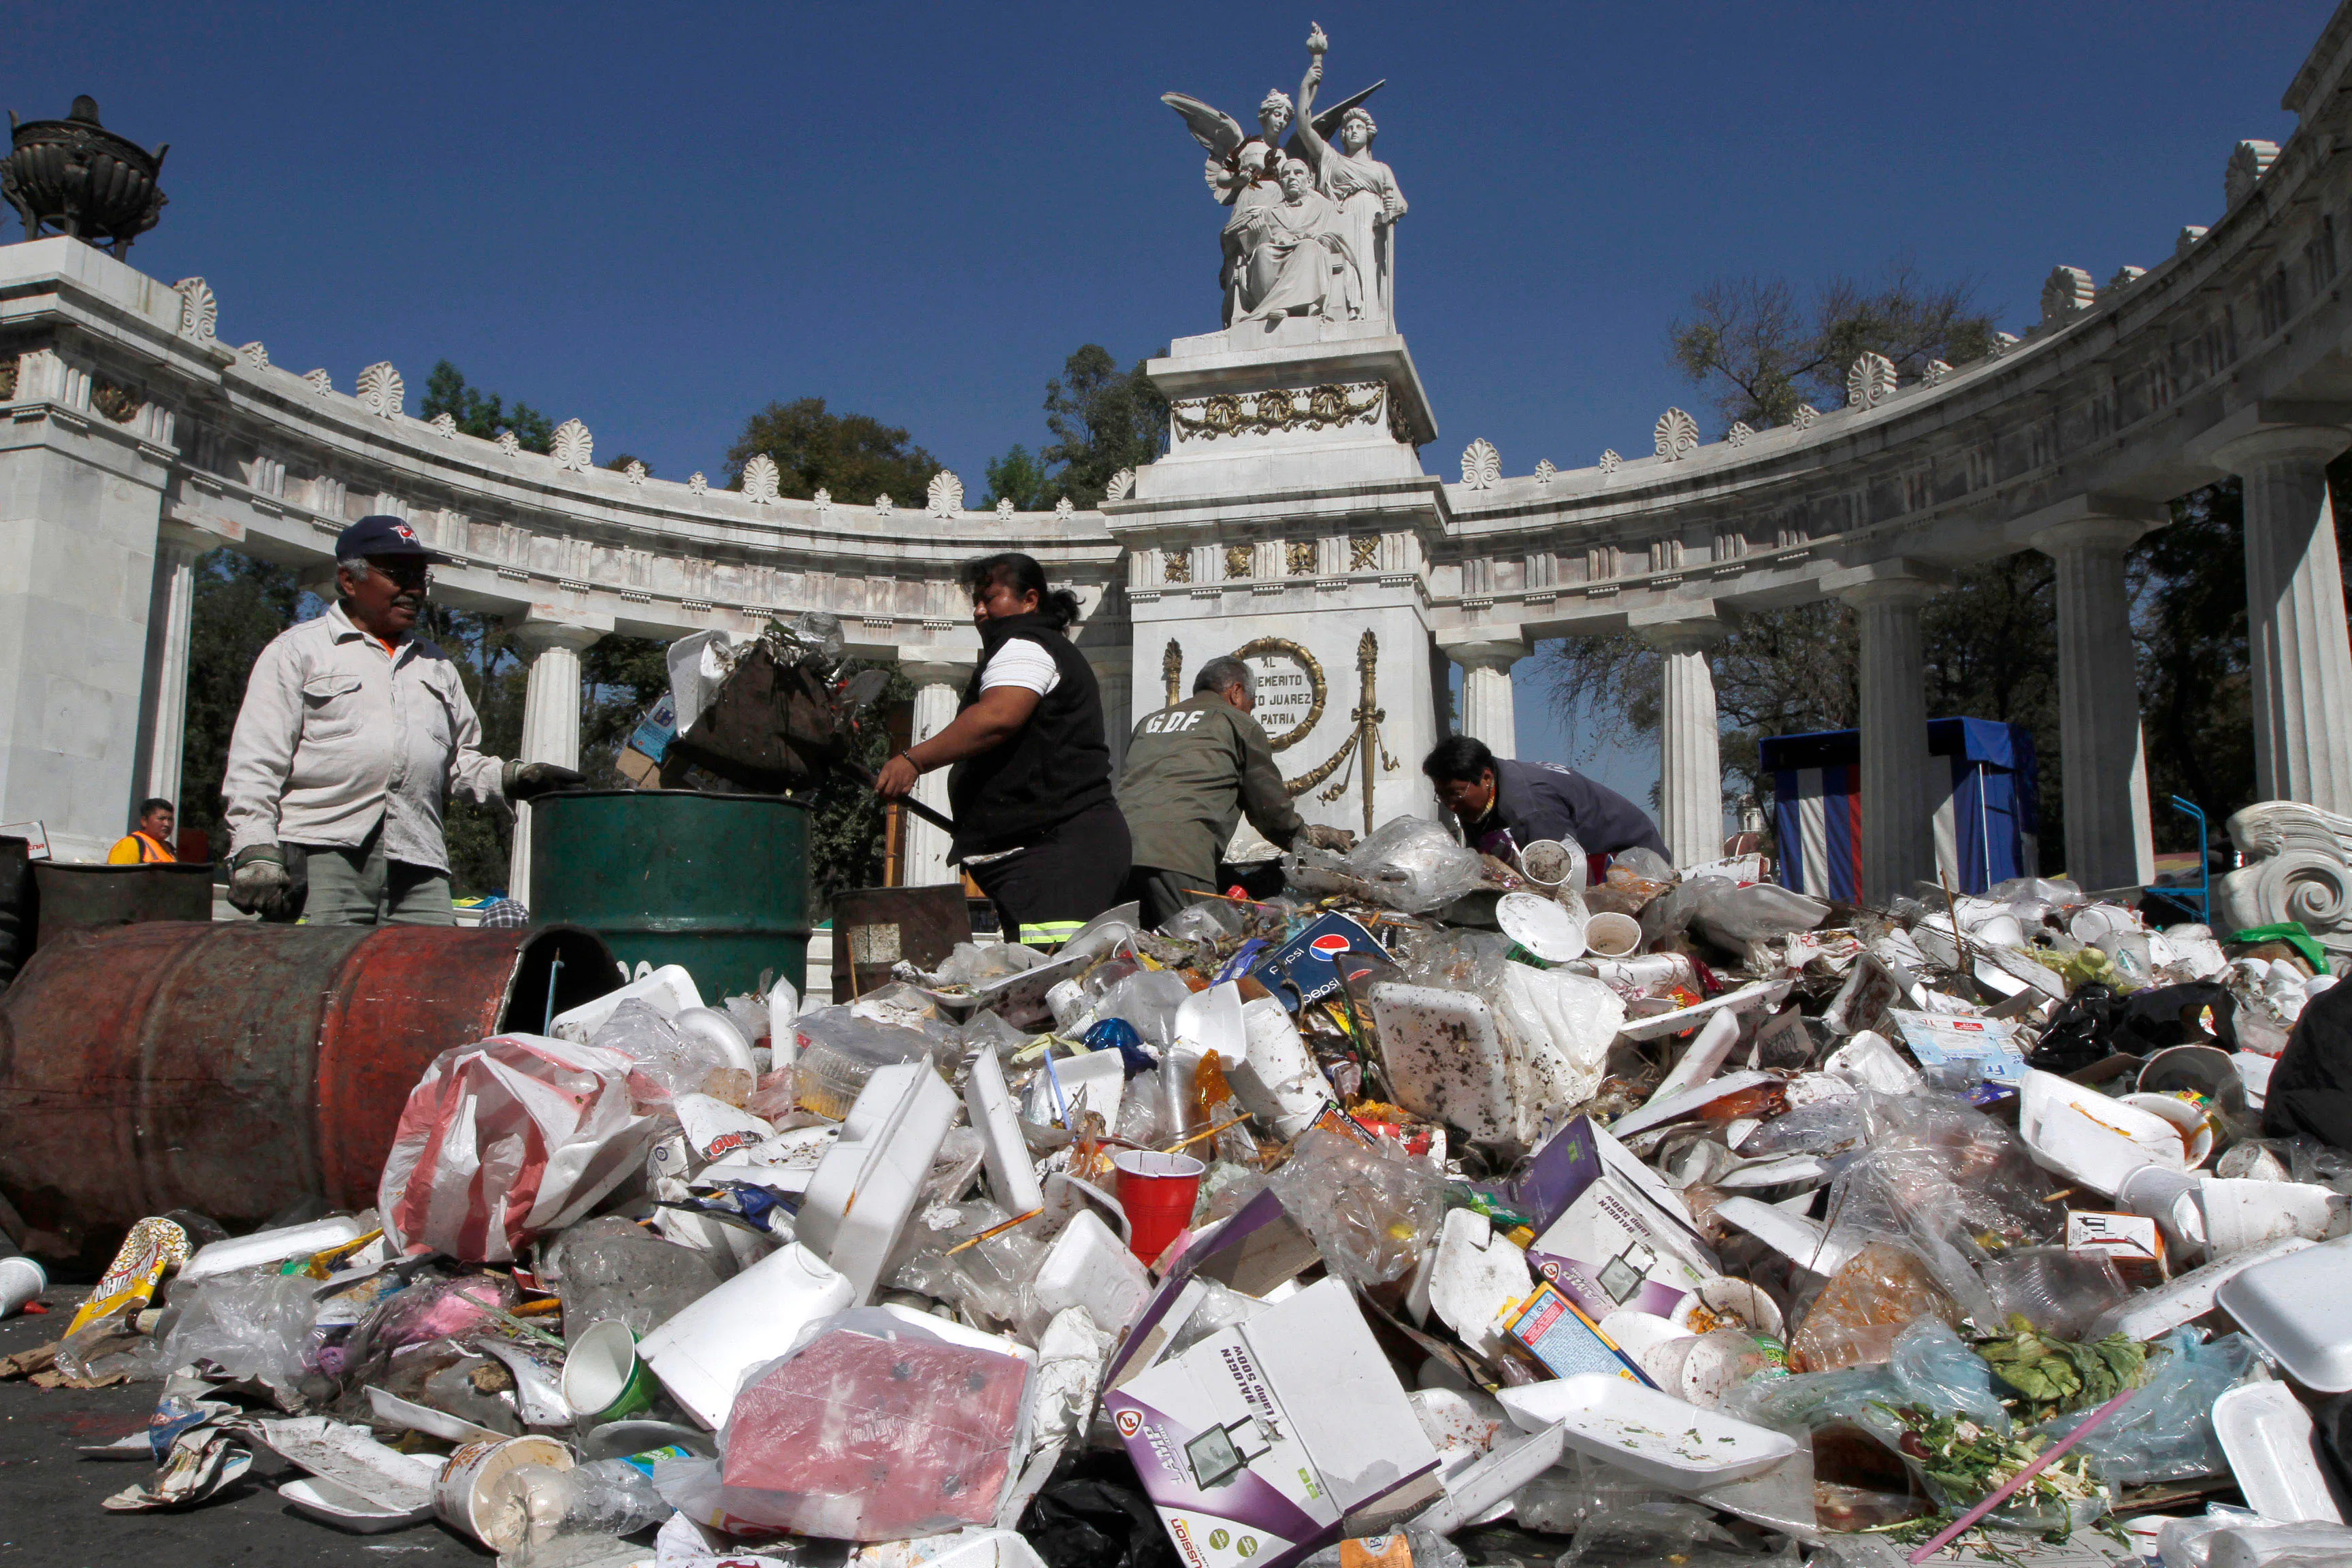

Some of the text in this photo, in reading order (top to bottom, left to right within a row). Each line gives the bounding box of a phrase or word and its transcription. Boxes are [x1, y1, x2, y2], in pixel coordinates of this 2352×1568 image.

[1262, 657, 1276, 668] AL
[1269, 693, 1311, 706] JUAREZ
[1260, 713, 1296, 725] PATRIA
[1269, 947, 1305, 975] ppsi
[1303, 977, 1341, 1006] pepsi
[1597, 1199, 1635, 1234] HALOGEN
[1220, 1348, 1256, 1403] HALOGEN
[1254, 1384, 1275, 1416] Lamp
[1143, 1424, 1186, 1484] LAMP
